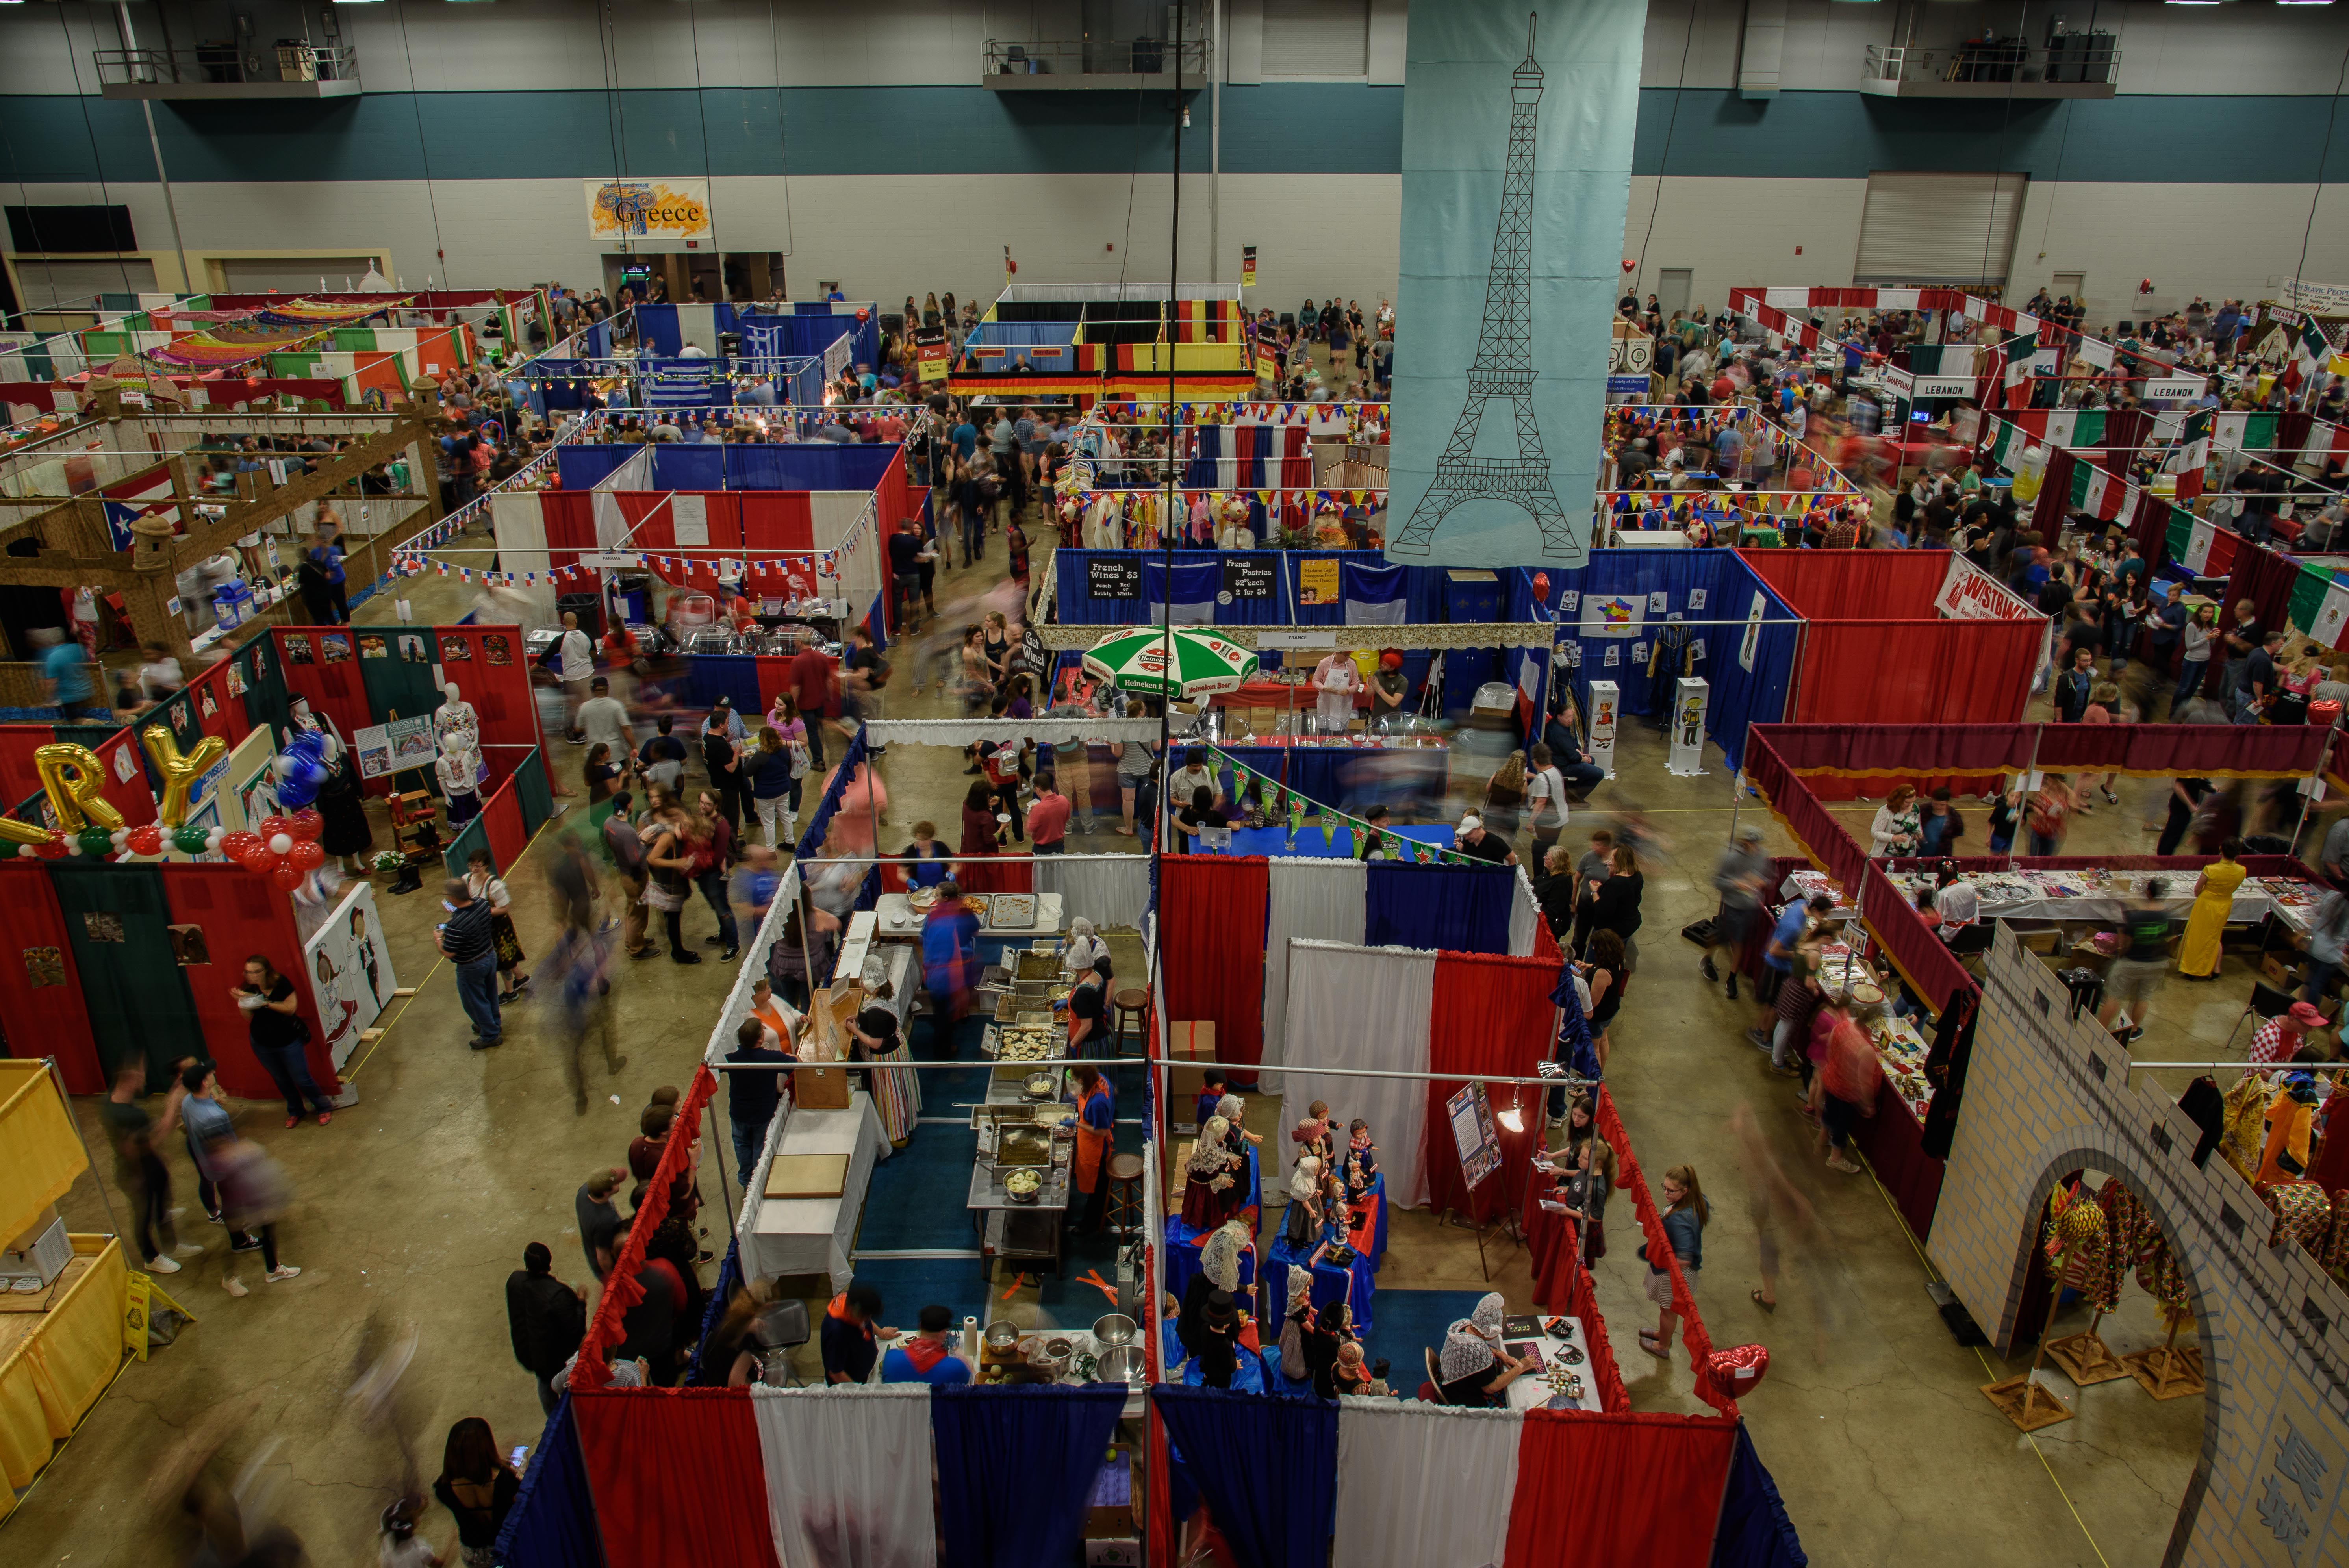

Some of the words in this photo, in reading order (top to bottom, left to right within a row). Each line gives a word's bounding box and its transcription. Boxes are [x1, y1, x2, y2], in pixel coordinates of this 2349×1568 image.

[616, 202, 699, 222] Greece
[2304, 284, 2325, 294] SLAVIC
[1261, 347, 1271, 357] Picnic
[112, 365, 143, 373] INDIAN
[1925, 386, 1964, 395] LEBANON
[2154, 388, 2194, 397] LEBANON
[1126, 571, 1138, 580] $3
[1026, 631, 1039, 649] Get
[1022, 643, 1045, 667] Wine!
[1140, 655, 1172, 664] Heinekn
[1125, 680, 1159, 689] Heineken
[1188, 683, 1216, 694] Heineken
[388, 719, 413, 728] KALOCSA
[389, 724, 415, 732] COSTUMES
[130, 1295, 143, 1305] CAUTION
